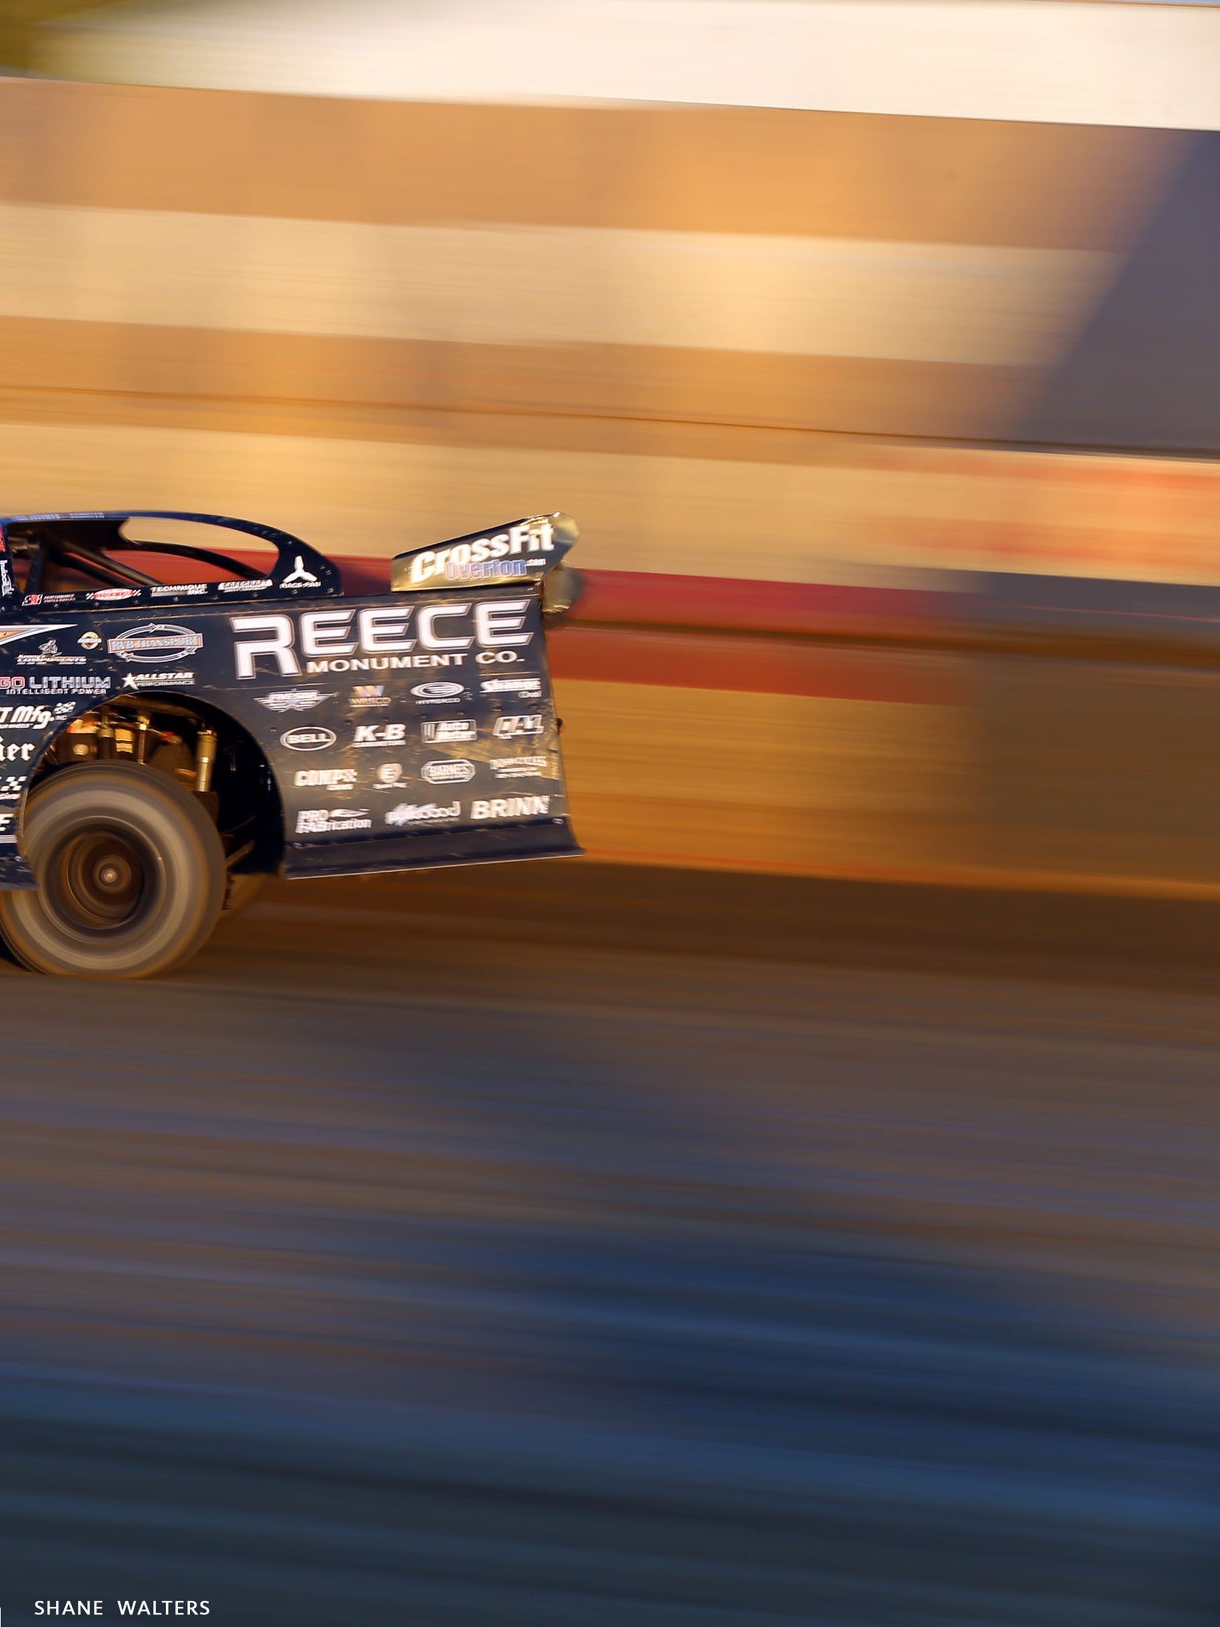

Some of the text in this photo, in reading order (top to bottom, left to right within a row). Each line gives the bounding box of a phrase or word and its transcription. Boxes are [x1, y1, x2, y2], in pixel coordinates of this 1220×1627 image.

[411, 523, 555, 582] CrossFit
[151, 584, 208, 592] TECHNIQUE
[231, 600, 535, 680] REECE
[306, 651, 525, 673] MONUMENT CO.
[29, 676, 111, 689] LITHIUM
[135, 672, 195, 680] ALLSTAR
[11, 705, 55, 729] Mfg.
[287, 733, 333, 744] BELL
[353, 723, 407, 743] K-B
[297, 809, 329, 821] PRO
[470, 795, 551, 820] BRINN
